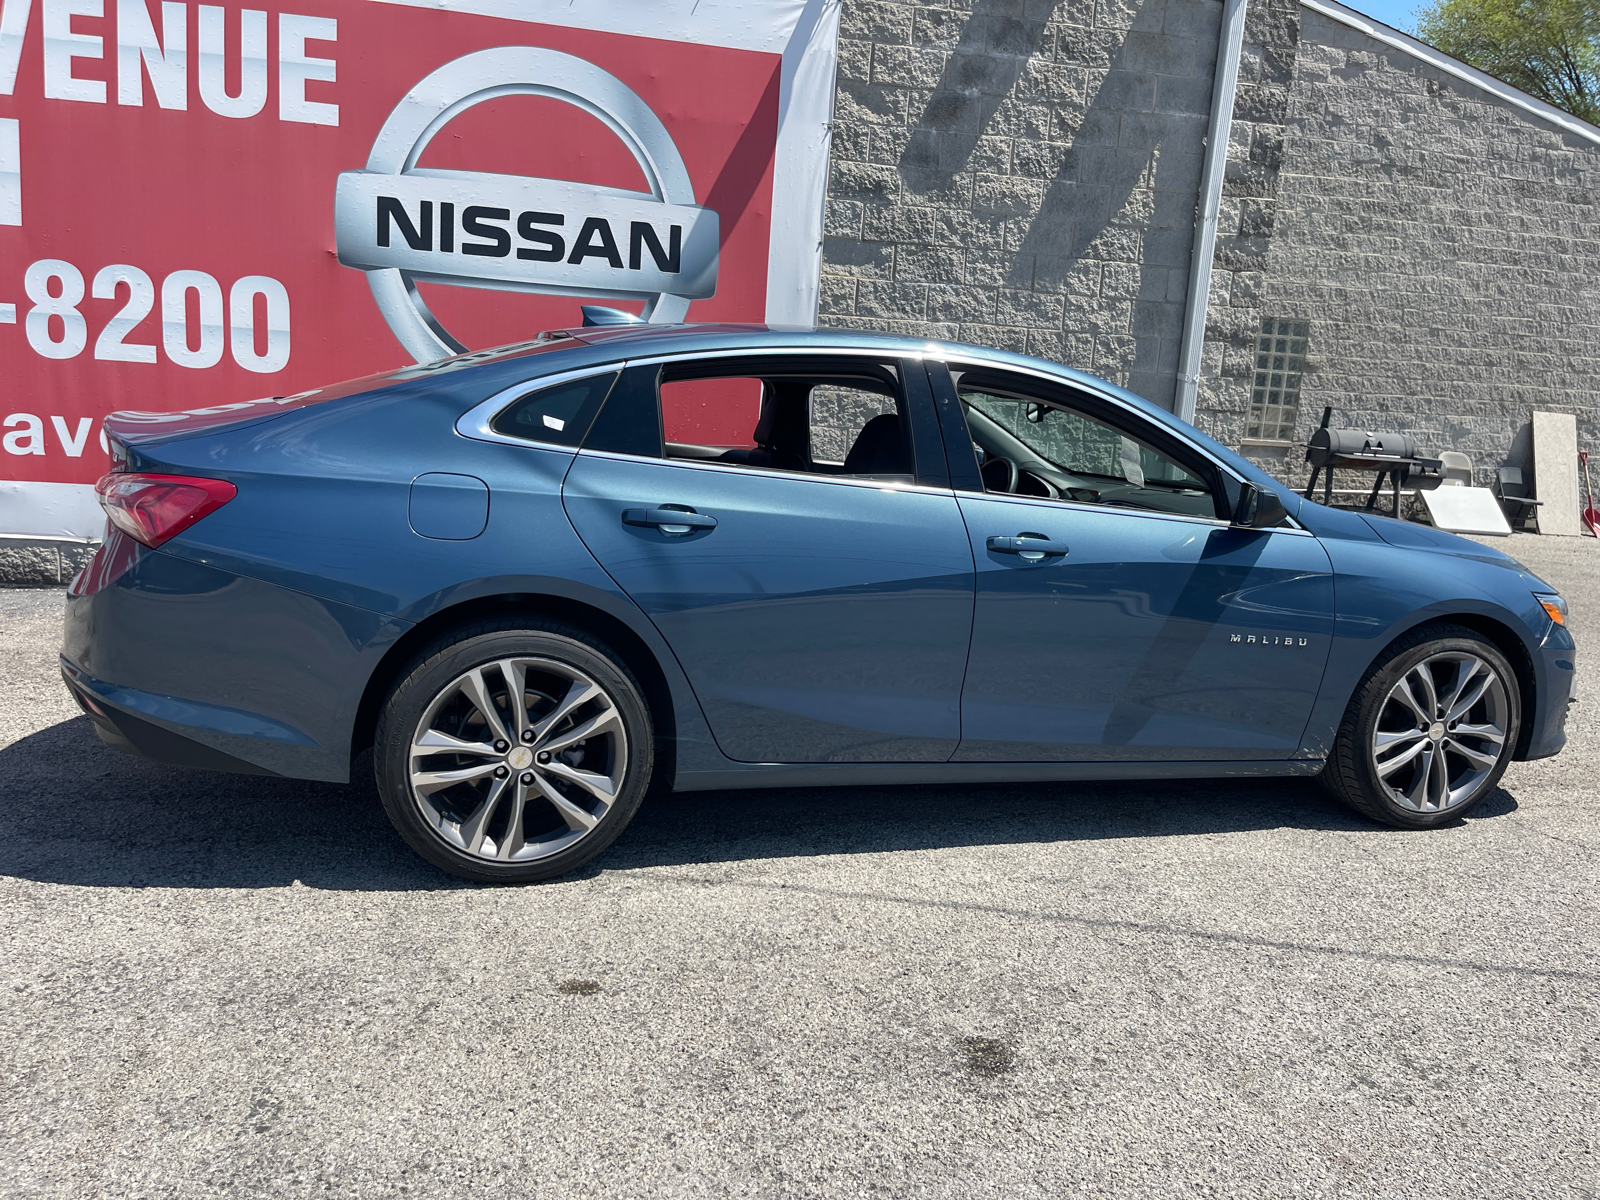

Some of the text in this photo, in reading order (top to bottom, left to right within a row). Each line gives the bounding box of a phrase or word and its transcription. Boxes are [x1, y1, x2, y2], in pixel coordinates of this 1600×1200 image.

[376, 196, 682, 274] NISSAN
[2, 412, 110, 457] av
[1229, 633, 1308, 646] MALIBU
